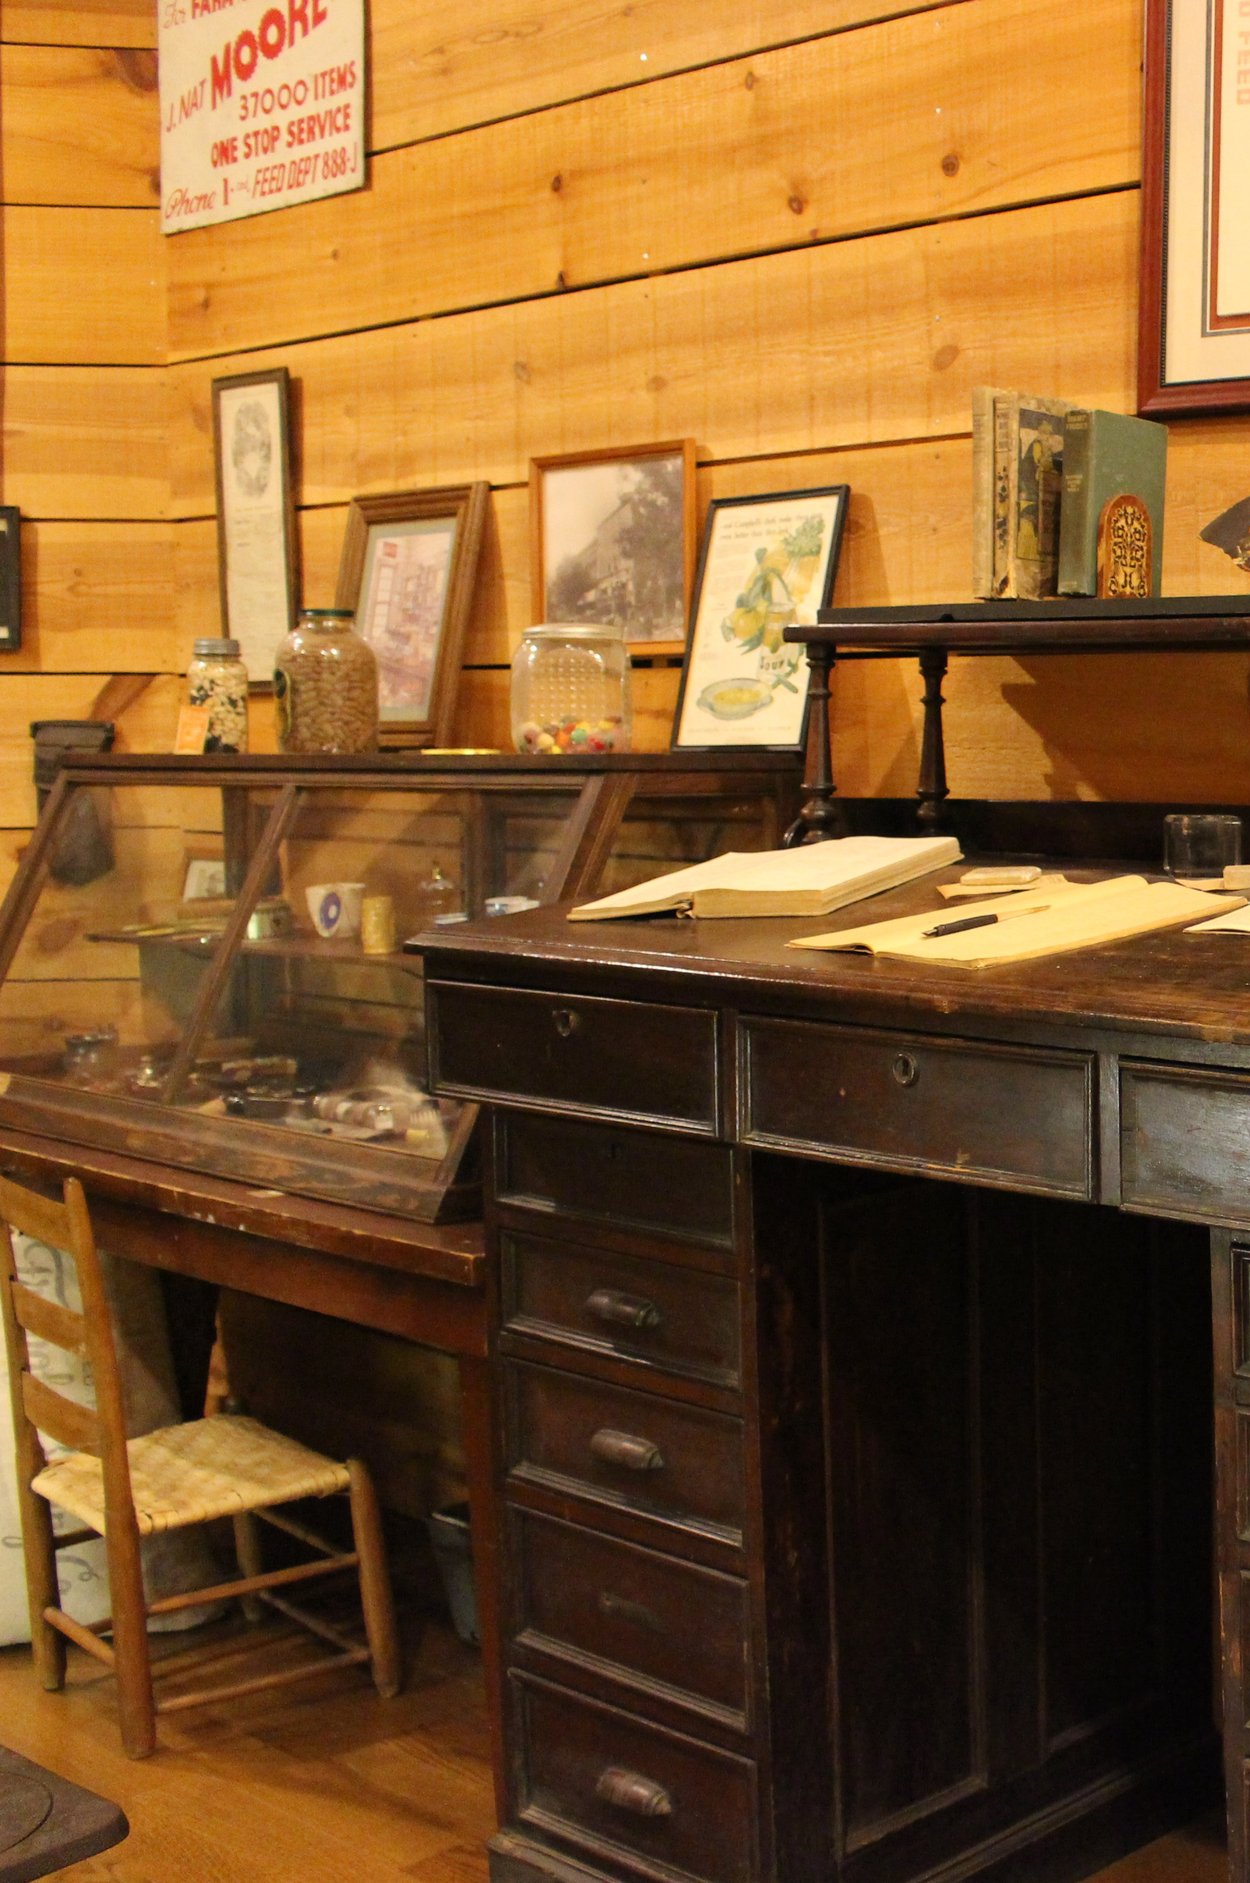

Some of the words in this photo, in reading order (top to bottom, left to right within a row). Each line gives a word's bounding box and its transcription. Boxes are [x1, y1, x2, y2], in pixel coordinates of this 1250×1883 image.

[178, 78, 208, 124] NAT
[239, 79, 310, 121] 37000
[314, 60, 357, 101] ITEMS
[211, 136, 239, 170] ONE
[243, 125, 282, 160] STOP
[286, 103, 352, 149] SERVICE
[165, 187, 217, 221] Phone
[252, 163, 287, 199] FEED
[287, 153, 321, 191] DEPT
